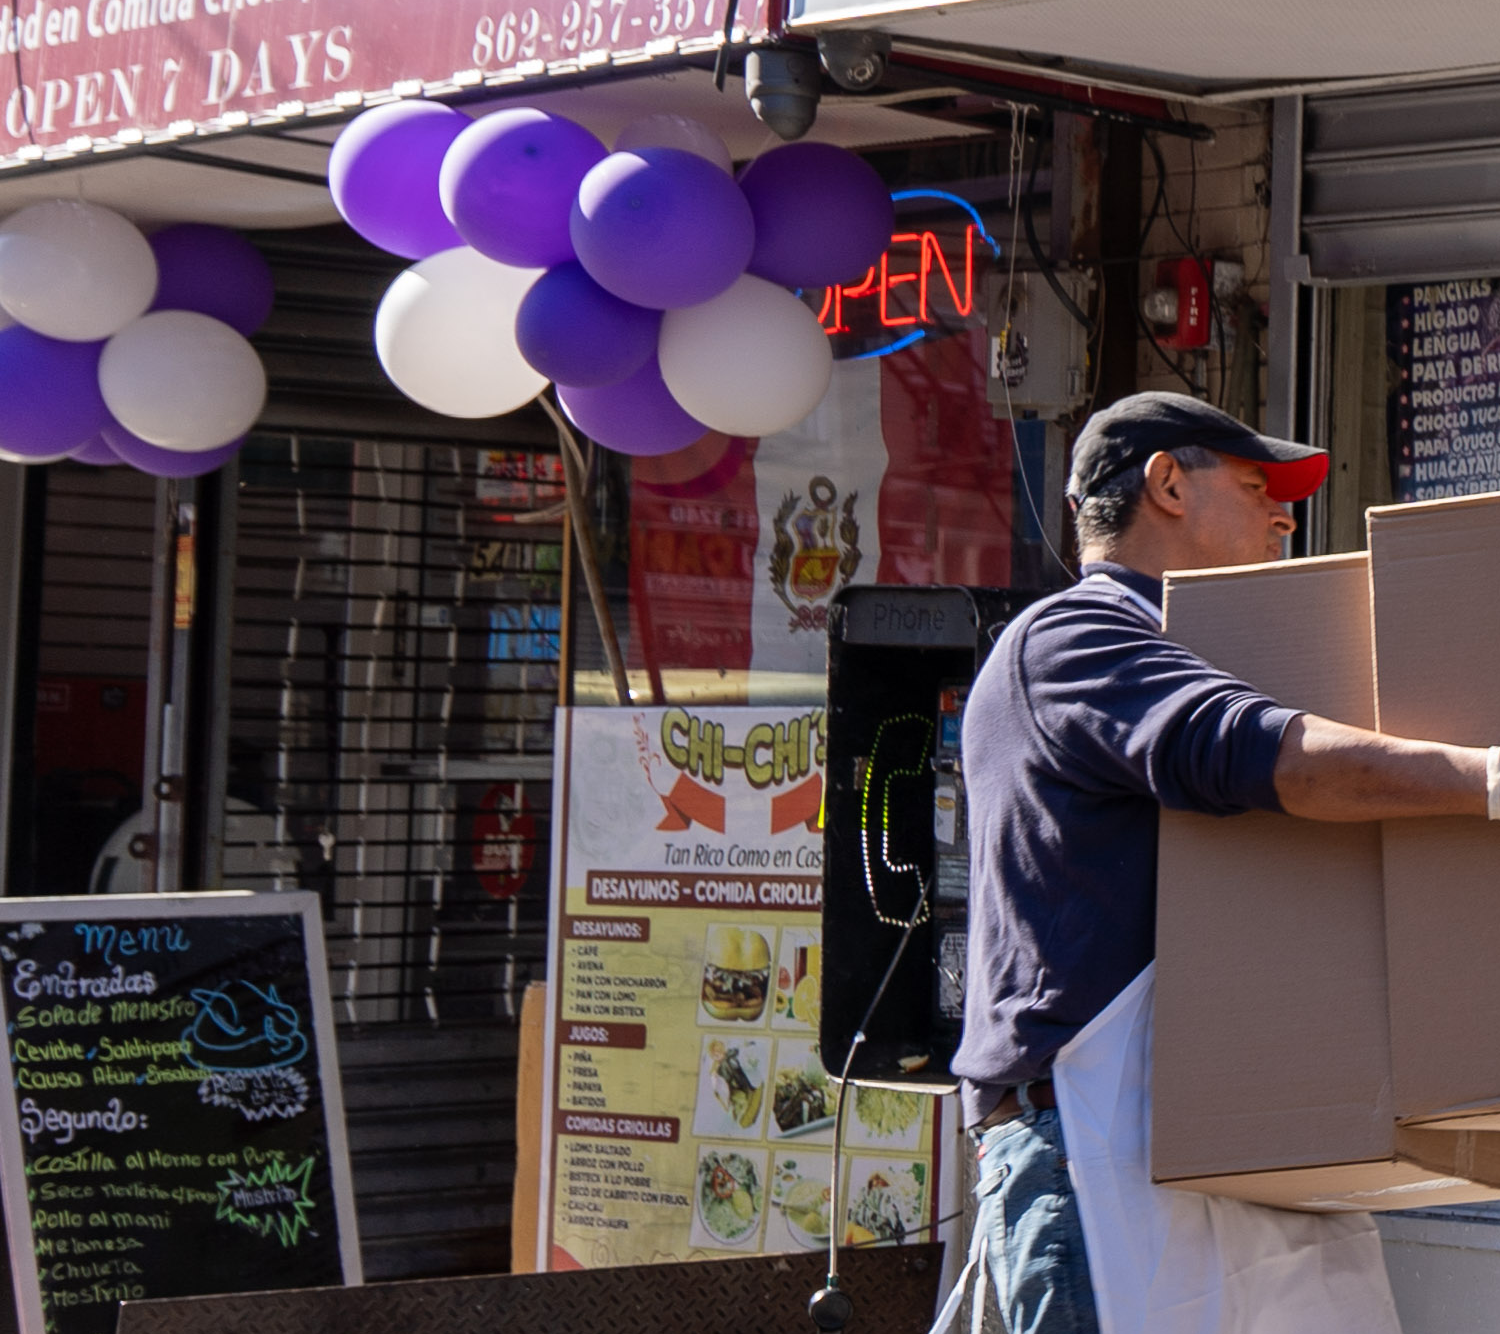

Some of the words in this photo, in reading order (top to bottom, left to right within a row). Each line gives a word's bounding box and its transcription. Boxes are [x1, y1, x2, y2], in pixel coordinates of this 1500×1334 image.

[45, 7, 81, 46] en
[5, 64, 148, 139] OPEN
[161, 58, 184, 118] 7
[206, 24, 354, 108] DAYS
[1413, 280, 1492, 307] PANCITAS
[1413, 304, 1481, 333] HIGADO
[1412, 358, 1457, 383] PATA
[1460, 354, 1483, 377] DE
[1412, 381, 1496, 408] PRODUCTOS
[1412, 409, 1468, 433] CHOCLO
[1413, 437, 1450, 458] PAPA
[1452, 430, 1496, 453] OYUCO
[873, 601, 947, 632] Phone
[664, 842, 691, 866] Tan
[693, 842, 724, 866] Rico
[727, 843, 770, 867] Como
[773, 848, 792, 867] en
[591, 877, 680, 901] DESAYUNOS
[694, 880, 756, 904] COMIDA
[13, 958, 158, 1001] Entradas
[565, 1115, 615, 1134] COMIDAS
[616, 1118, 672, 1138] CRIOLLAS
